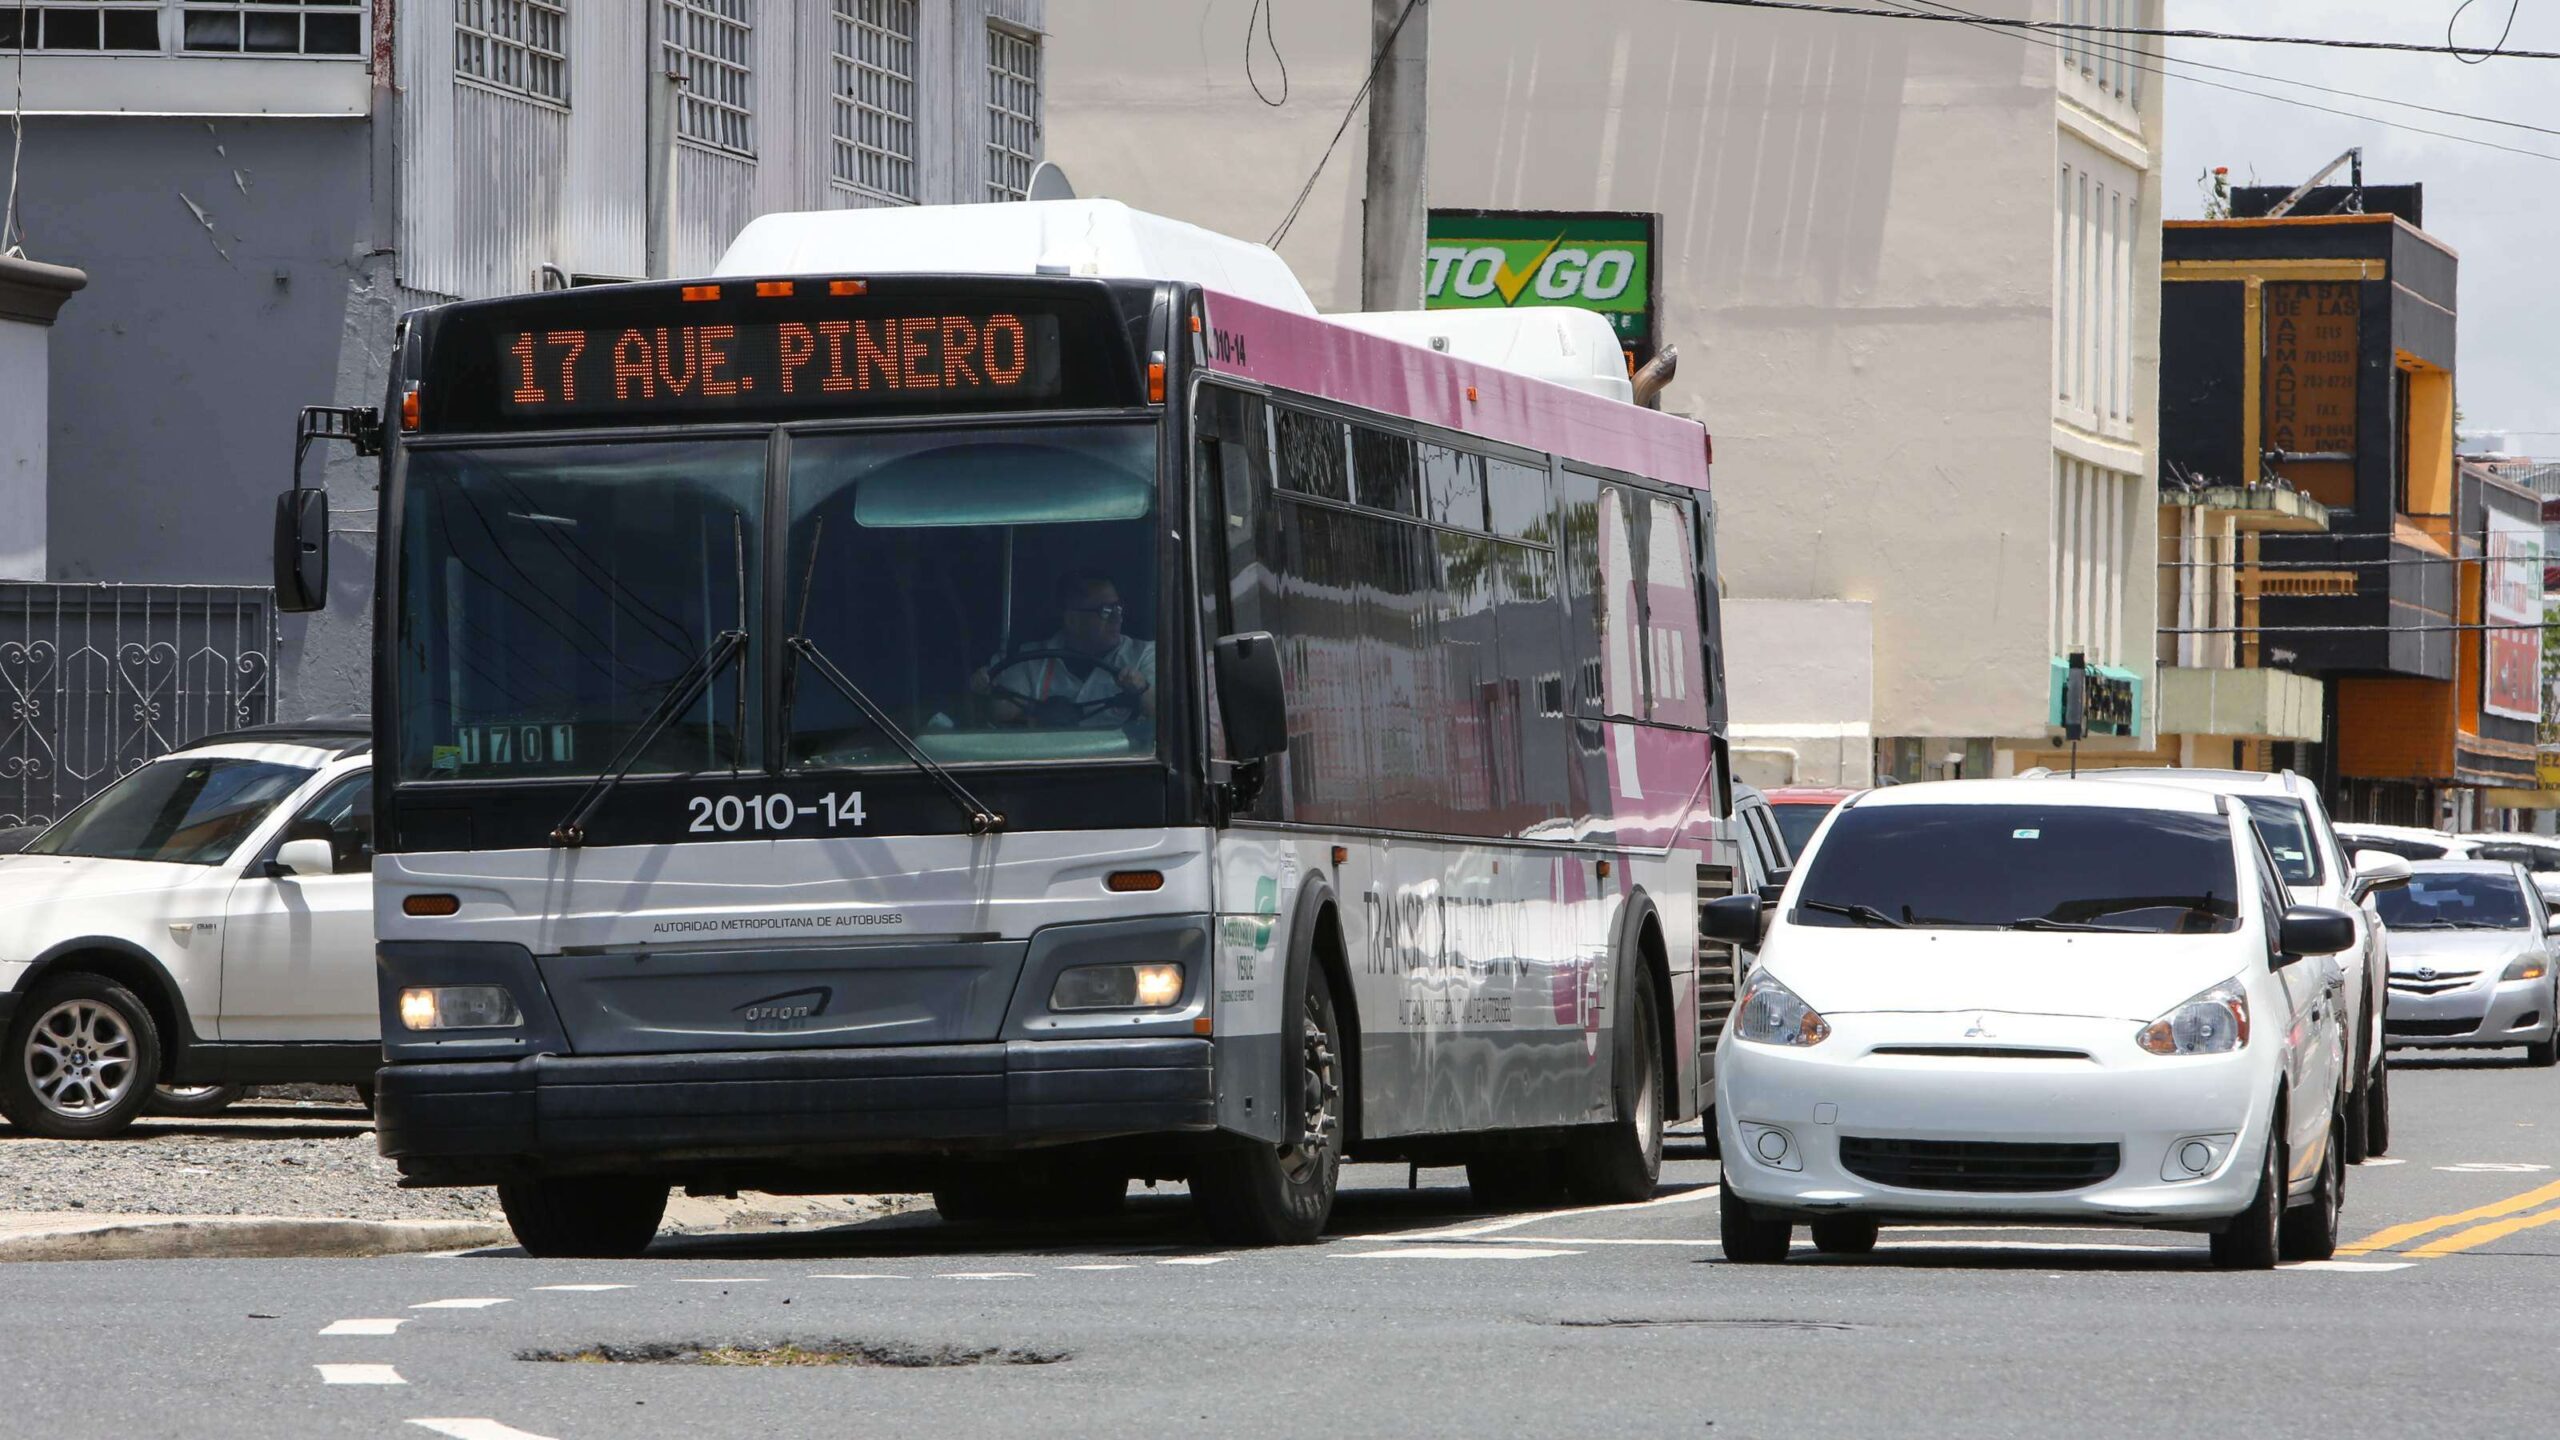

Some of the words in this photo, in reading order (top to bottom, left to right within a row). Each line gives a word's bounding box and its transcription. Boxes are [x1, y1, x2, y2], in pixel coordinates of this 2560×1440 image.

[1427, 246, 1505, 299] TO
[1535, 248, 1635, 301] GO
[2275, 300, 2301, 316] DE
[2317, 299, 2356, 316] LAS
[511, 329, 586, 404] 17
[612, 324, 754, 401] AVE.
[778, 312, 1027, 395] PINERO
[463, 723, 572, 763] 1701
[688, 790, 868, 834] 2010-14
[653, 920, 718, 934] AUTORIDAD
[721, 916, 815, 931] METROPOLITANA
[816, 916, 832, 928] DE
[835, 913, 904, 927] AUTOBUSES
[1363, 890, 1465, 975] TRANSPORTE
